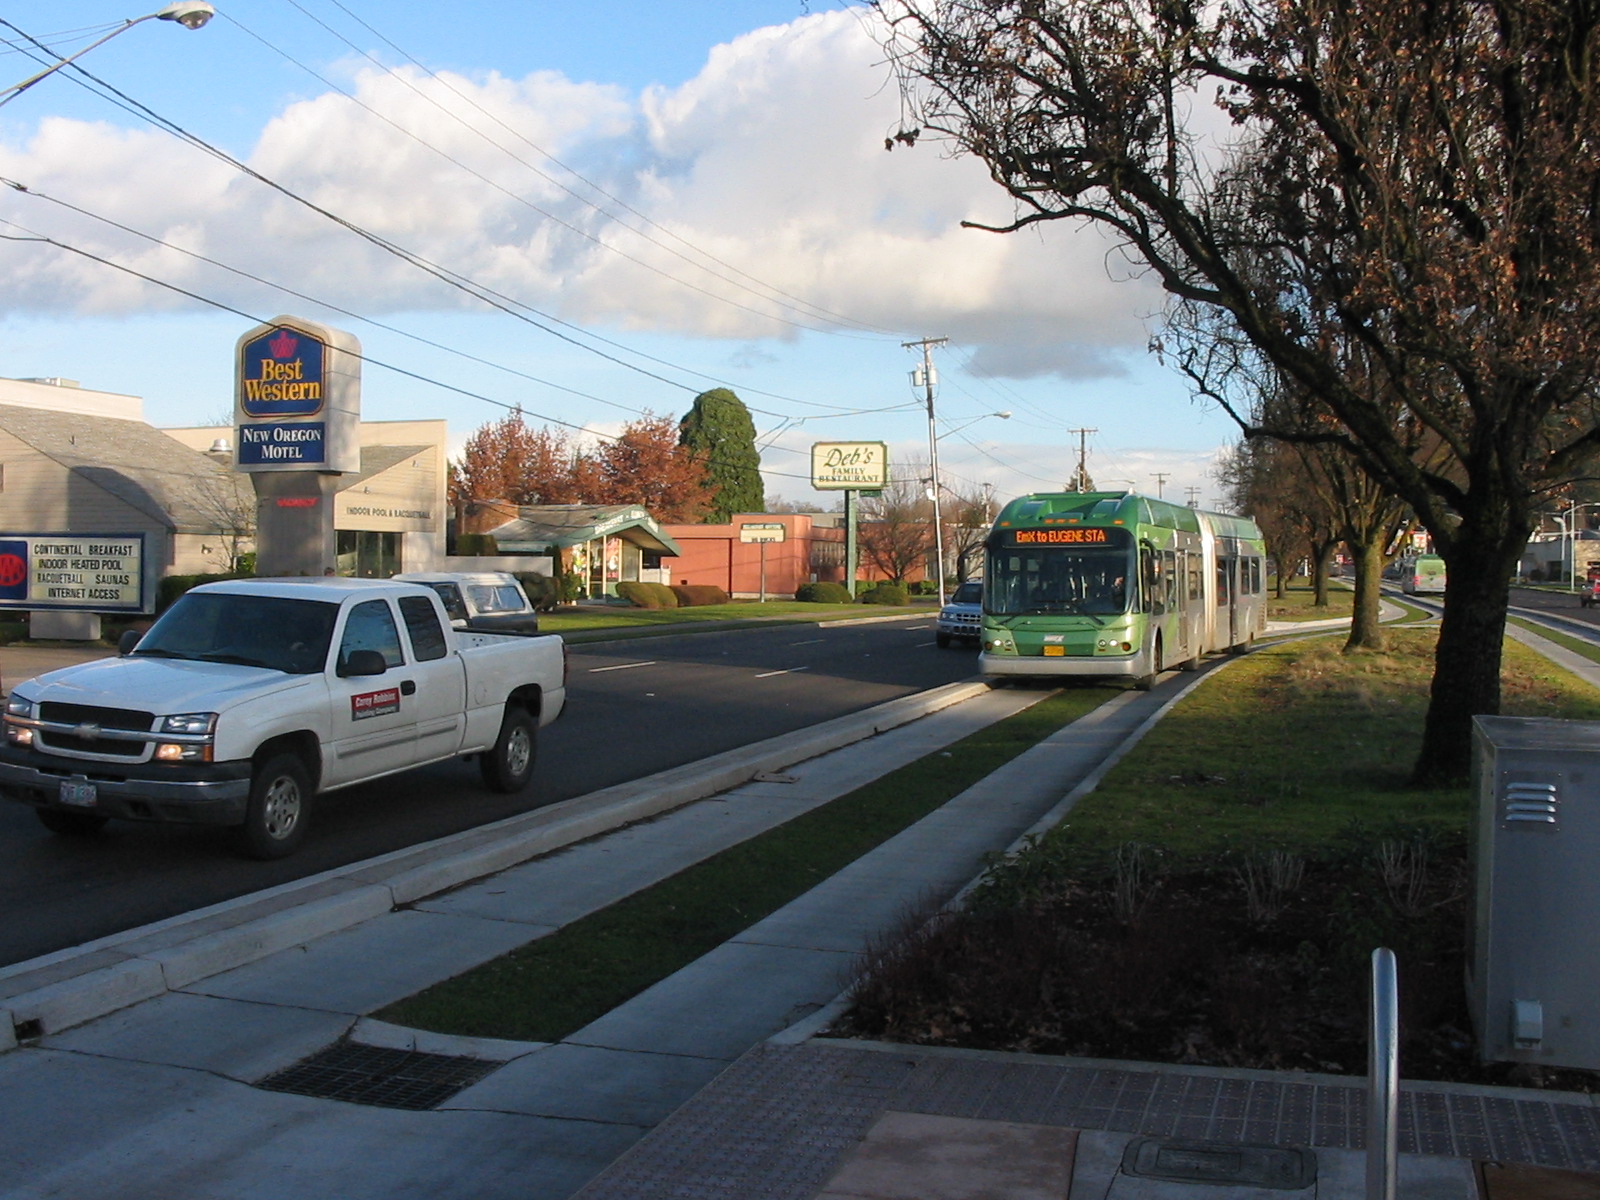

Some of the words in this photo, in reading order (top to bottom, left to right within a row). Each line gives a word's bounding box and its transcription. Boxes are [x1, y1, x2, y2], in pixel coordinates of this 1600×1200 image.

[261, 357, 303, 381] Best
[244, 379, 321, 401] Western
[823, 447, 873, 467] Deb's
[832, 467, 865, 475] FAMILY
[819, 475, 879, 483] RESTAURANT
[346, 506, 371, 516] INDOOR
[372, 507, 388, 517] POOL
[1037, 531, 1047, 542] to
[1048, 530, 1084, 542] EUGENE
[1085, 529, 1105, 542] STA
[34, 544, 83, 556] CONTINENTAL
[88, 544, 133, 556] BREAKFAST
[38, 559, 68, 569] INDOOR
[70, 560, 100, 570] HEATED
[101, 560, 122, 571] POOL
[37, 572, 84, 584] RACQUETBALL
[95, 574, 130, 585] SAUNAS
[48, 587, 86, 599] INTERNET
[88, 588, 120, 600] ACCESS
